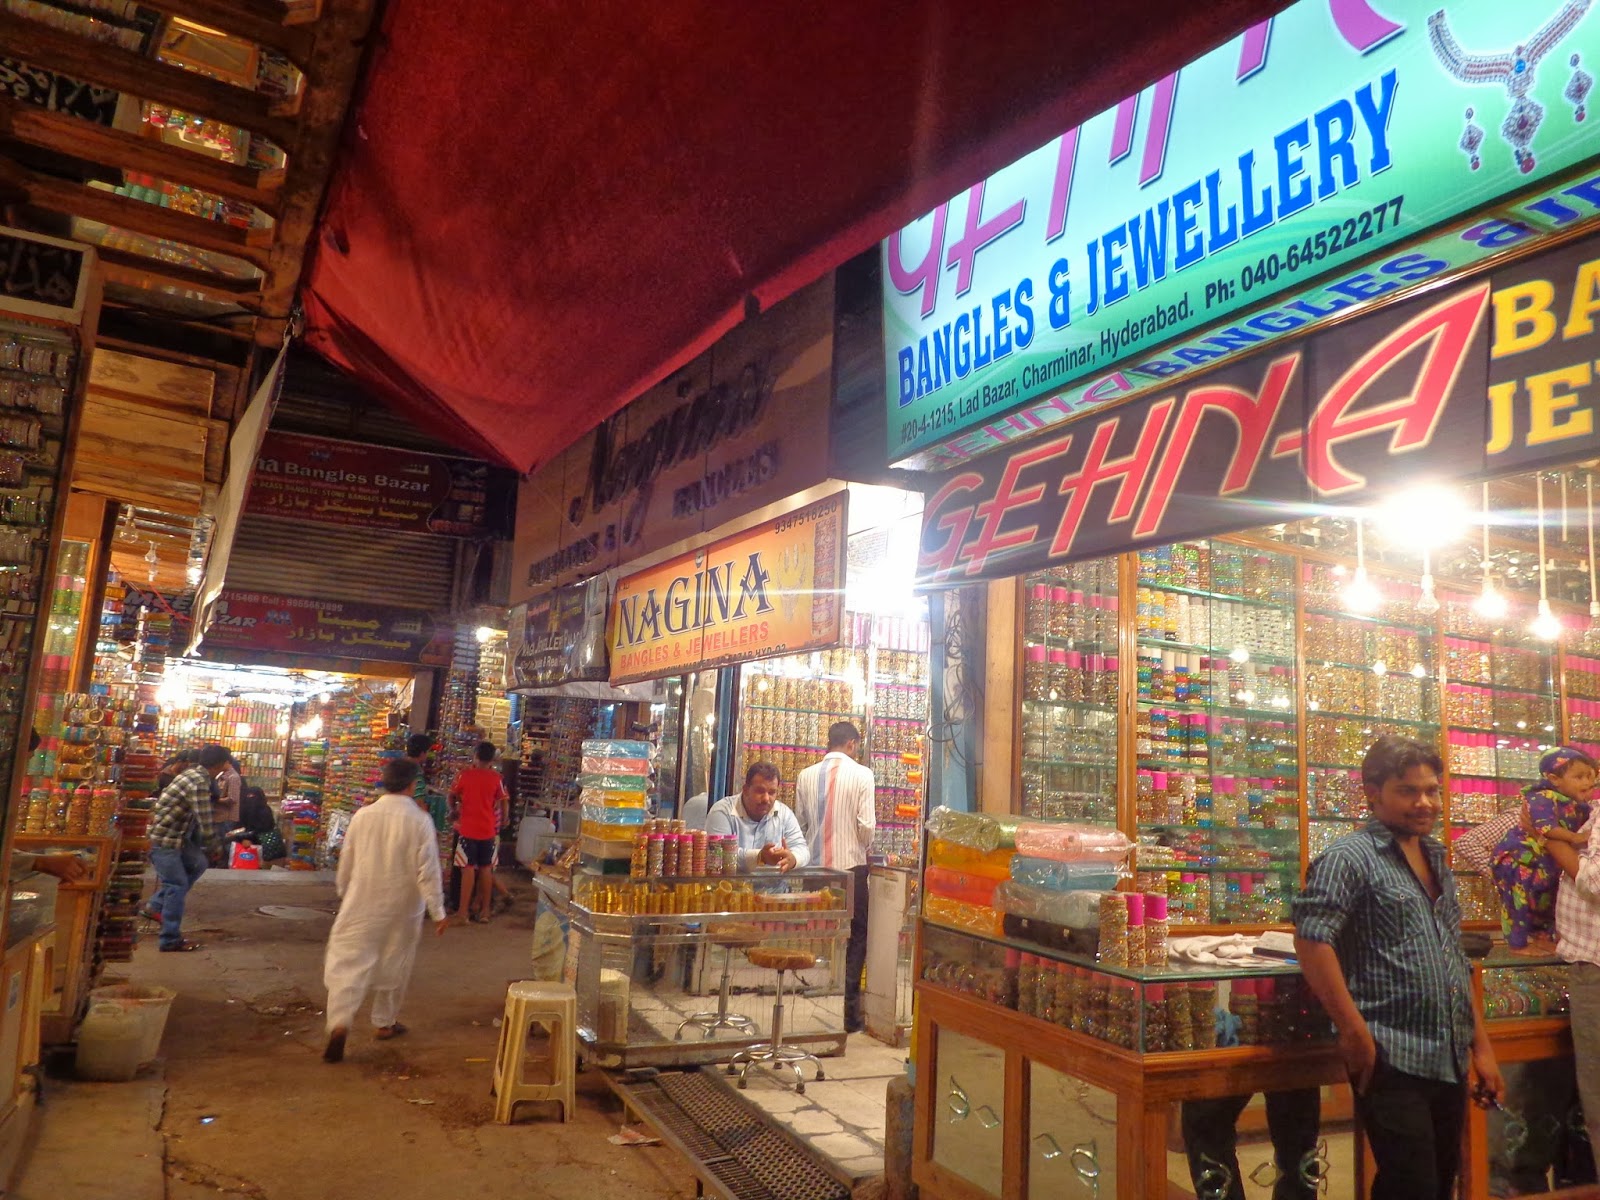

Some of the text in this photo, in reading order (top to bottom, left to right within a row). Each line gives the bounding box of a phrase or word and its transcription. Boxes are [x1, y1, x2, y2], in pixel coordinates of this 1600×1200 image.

[897, 277, 1036, 408] BANGLES
[1048, 257, 1071, 328] &
[1086, 68, 1399, 315] JEWELLERY
[959, 393, 981, 418] Lad
[983, 377, 1019, 408] Bazar,
[1022, 342, 1096, 389] Charminar,
[1100, 293, 1194, 357] Hyderabad.
[1205, 278, 1235, 309] Ph:
[1241, 195, 1405, 292] 040-64522277
[935, 370, 1135, 464] EHNA
[1130, 252, 1451, 380] BANGLES
[1487, 360, 1600, 455] JE
[285, 462, 367, 485] Bangles
[374, 470, 430, 493] Bazar
[123, 590, 229, 614] MEEA
[615, 551, 776, 650] NAGINA
[620, 621, 769, 670] BANGLES & JEWELLERS
